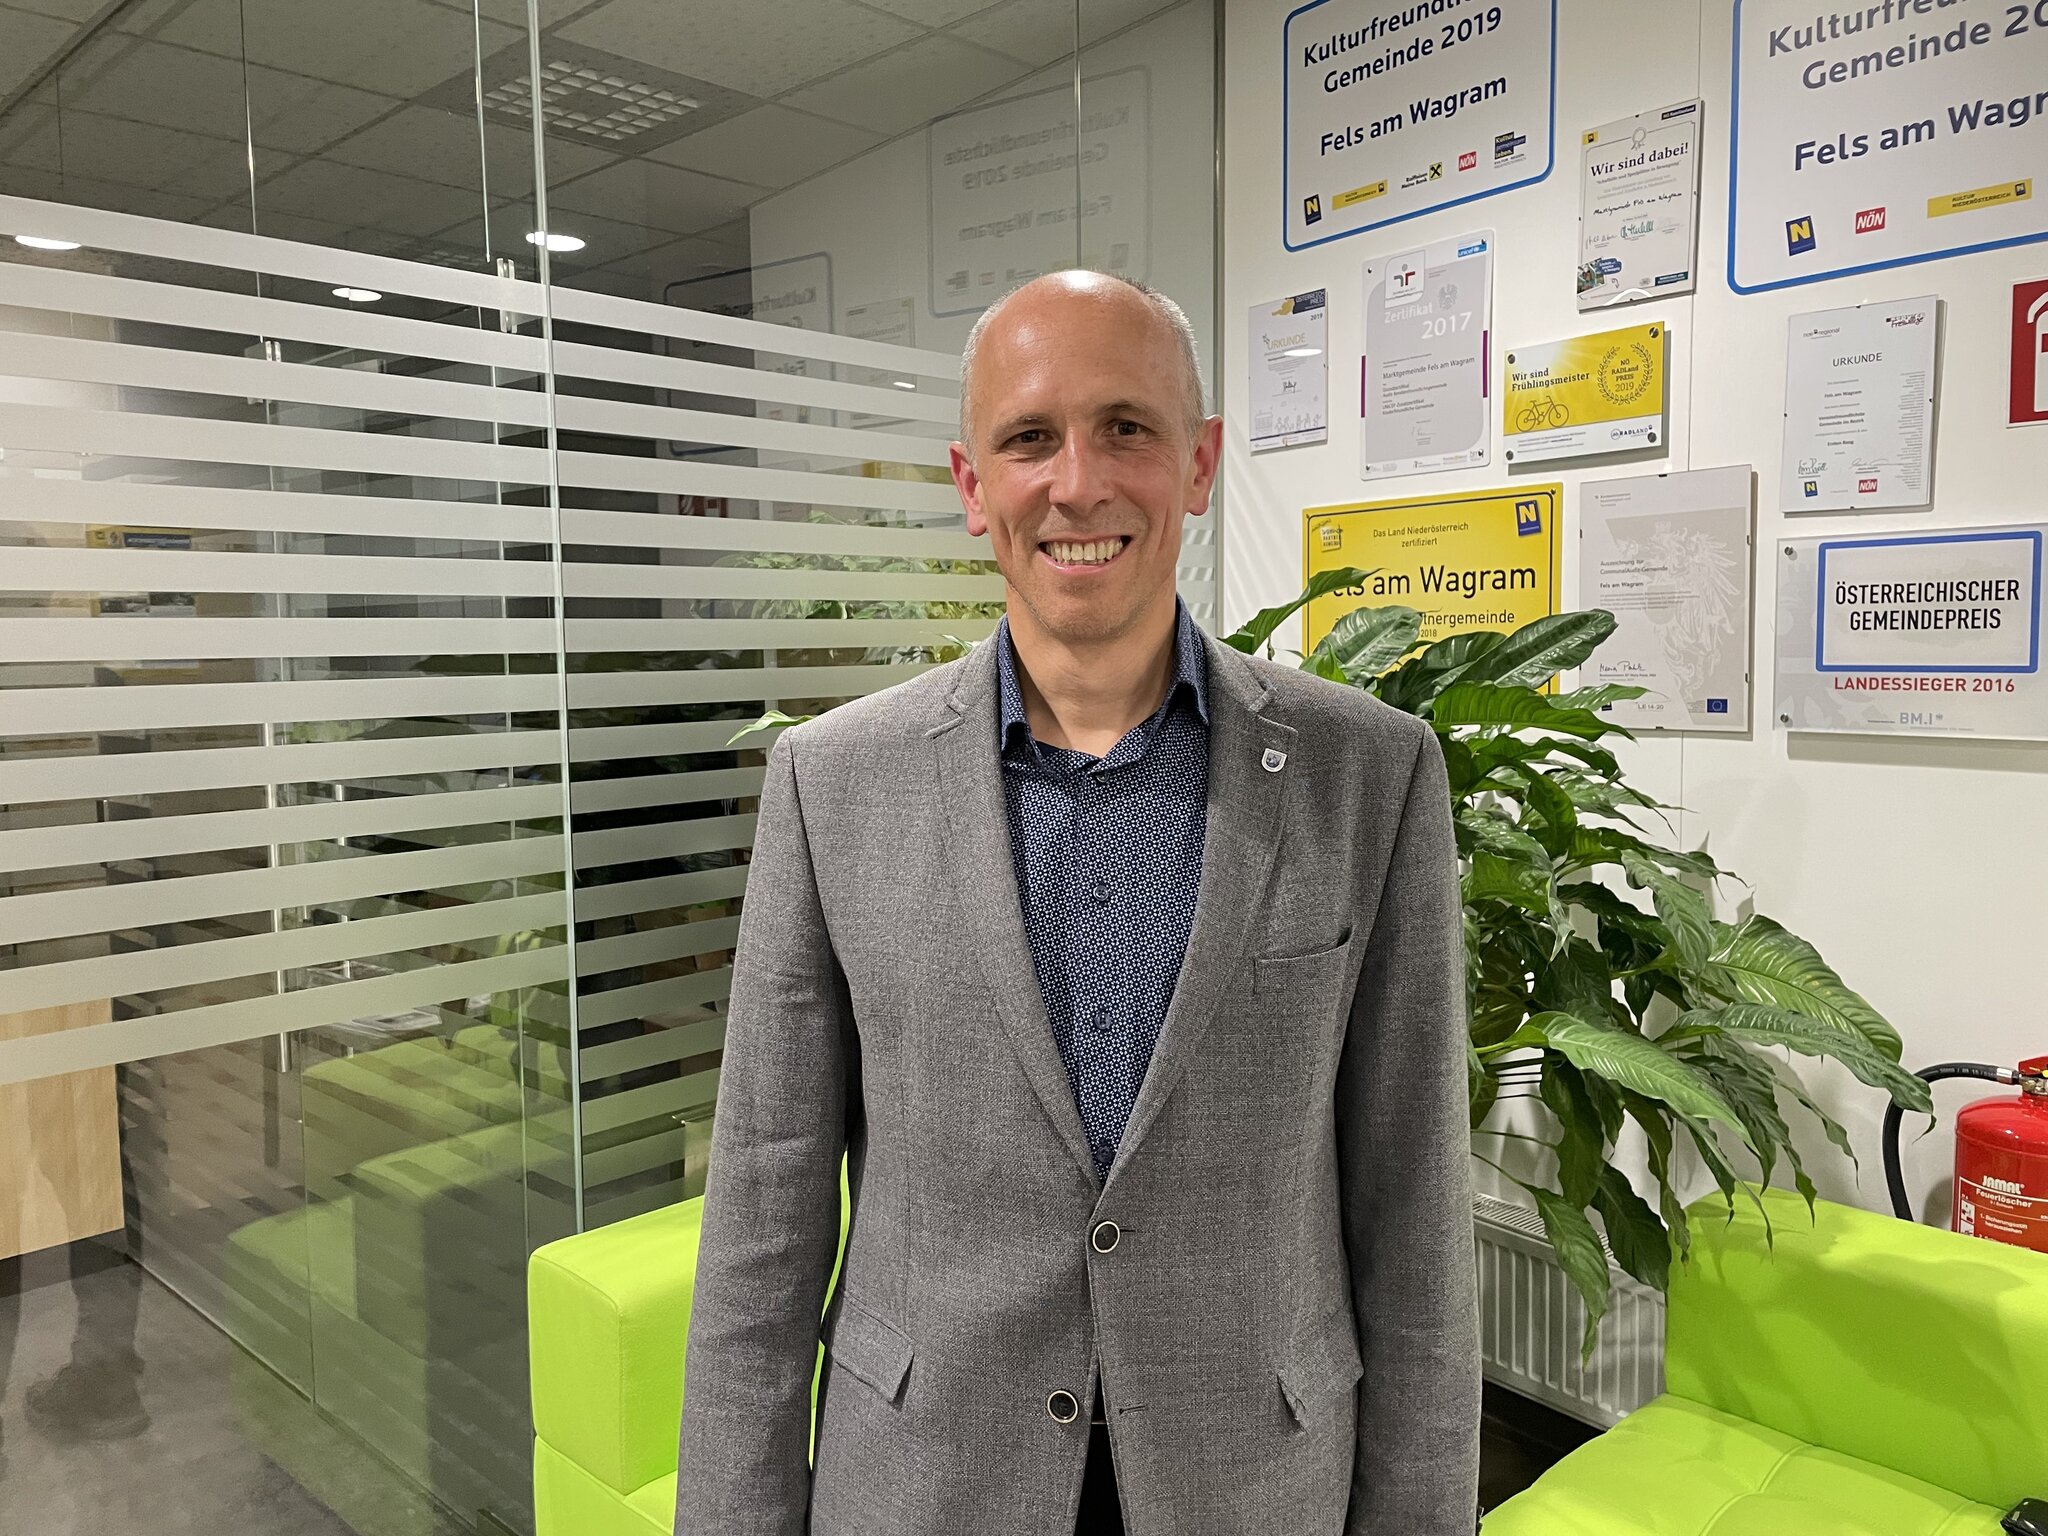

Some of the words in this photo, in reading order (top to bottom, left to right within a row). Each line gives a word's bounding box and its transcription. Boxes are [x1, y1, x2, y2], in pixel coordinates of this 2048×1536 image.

[1304, 0, 1471, 67] Kulturfreund
[1324, 37, 1433, 93] Gemeinde
[1441, 7, 1502, 50] 2019
[1803, 21, 1991, 89] Gemeinde
[1321, 127, 1364, 156] Fels
[1370, 114, 1402, 138] am
[1410, 77, 1506, 124] Wagram
[1795, 134, 1868, 171] Fels
[1879, 119, 1935, 150] am
[1459, 153, 1476, 169] NÖN
[1591, 162, 1615, 177] Wir
[1618, 153, 1645, 171] sind
[1649, 142, 1689, 162] dabei!
[1857, 211, 1885, 230] NÖN
[1790, 220, 1811, 243] N
[1385, 302, 1433, 323] Zertifikat
[1421, 311, 1473, 339] 2017
[1383, 365, 1427, 379] Marktgemeinde
[1427, 363, 1439, 372] Fels
[1450, 357, 1475, 367] Wagram
[1833, 352, 1883, 367] URKUNDE
[1512, 372, 1527, 382] Wir
[1530, 367, 1549, 378] sind
[1512, 372, 1590, 392] Frühlingsmeister
[1615, 373, 1634, 382] PREIS
[1615, 382, 1634, 392] 2019
[1859, 480, 1877, 491] NÖN
[1519, 502, 1537, 523] N
[1373, 529, 1386, 538] Das
[1388, 527, 1406, 537] Land
[1407, 521, 1469, 535] Niederösterreich
[1401, 537, 1438, 548] zertifiziert
[1373, 574, 1410, 595] am
[1420, 565, 1536, 598] Wagram
[1835, 580, 2020, 605] ÖSTERREICHISCHER
[1421, 609, 1515, 628] tnergemeinde
[1850, 608, 2001, 631] GEMEINDEPREIS
[1420, 629, 1437, 638] 2018
[1834, 677, 1967, 692] LANDESSIEGER
[1972, 678, 2016, 692] 2016
[1976, 1188, 2033, 1208] Feuerlöscher
